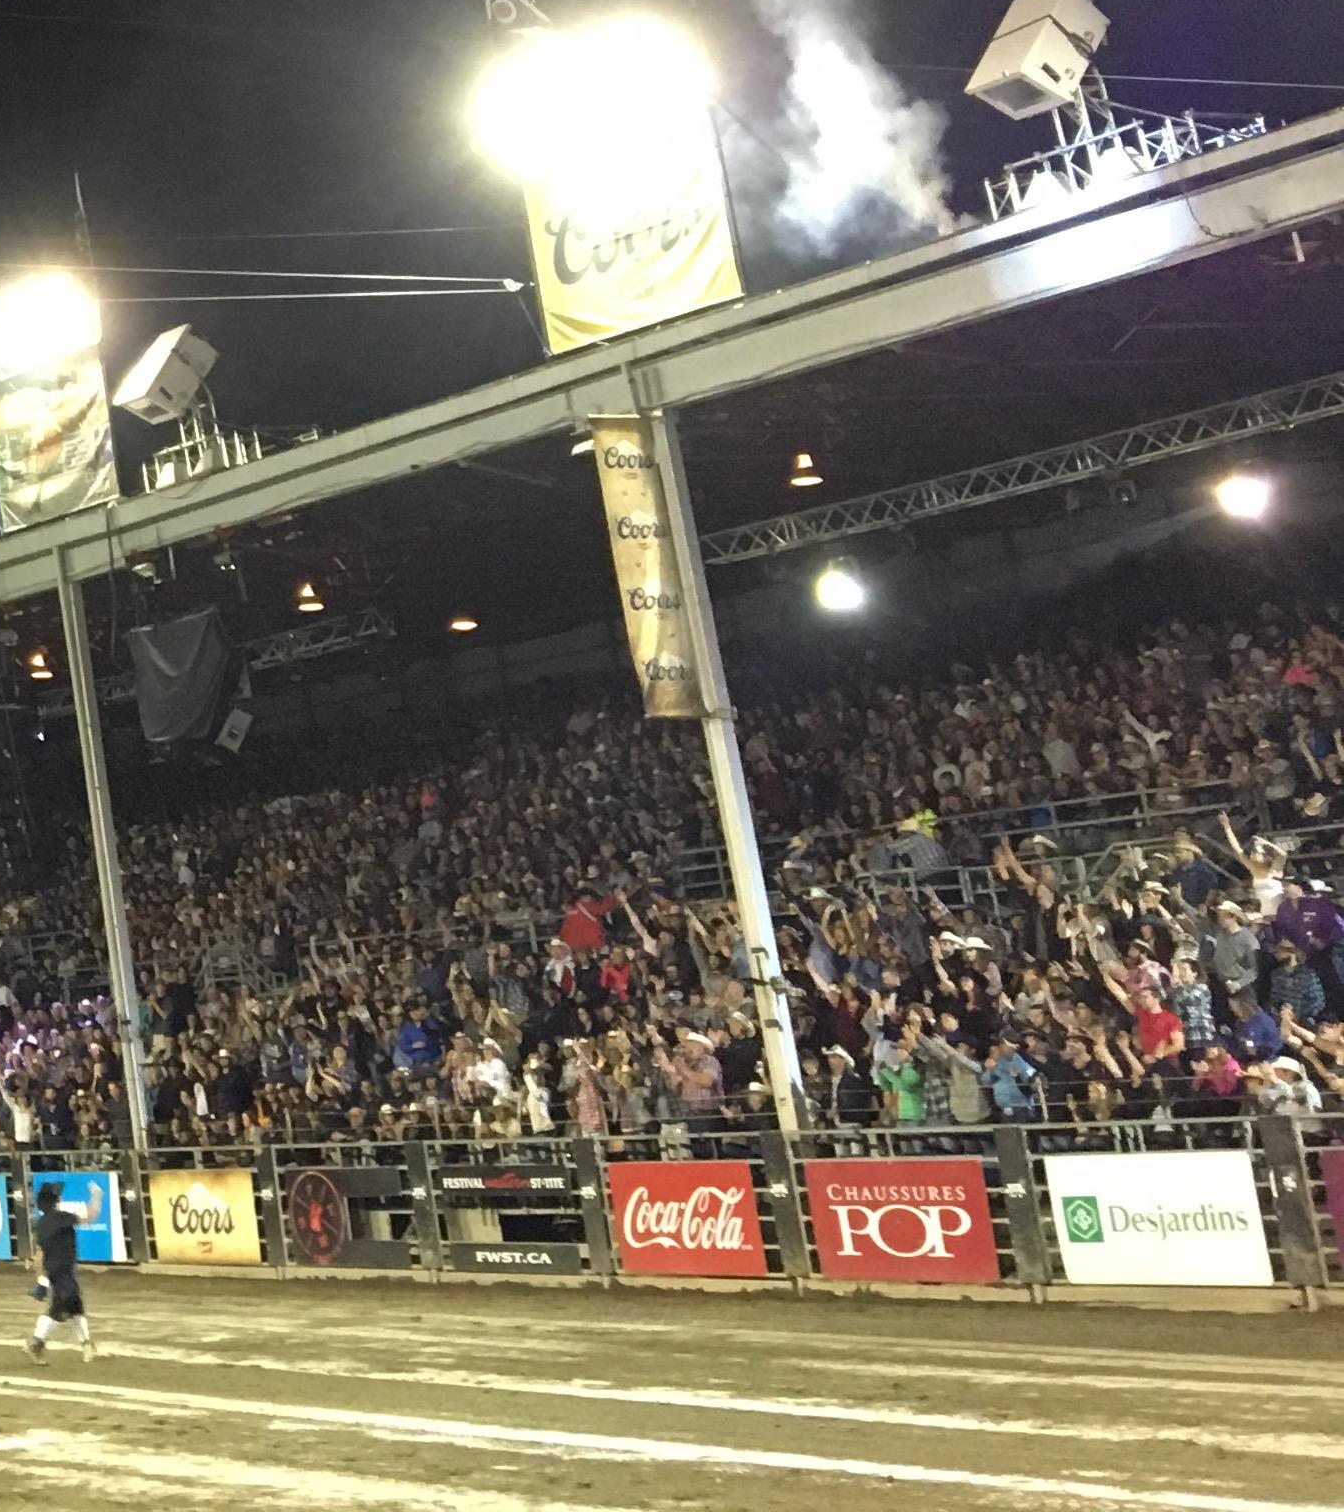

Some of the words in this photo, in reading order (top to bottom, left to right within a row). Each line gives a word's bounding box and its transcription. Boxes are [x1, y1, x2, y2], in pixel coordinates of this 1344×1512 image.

[442, 1177, 486, 1189] FESTIVAL
[827, 1183, 967, 1201] CHAUSSURES
[169, 1194, 235, 1234] Coors
[624, 1186, 746, 1250] Coca-Cola
[829, 1205, 972, 1257] POP
[1108, 1204, 1249, 1240] Desjardins
[475, 1251, 552, 1265] FWST.CA
